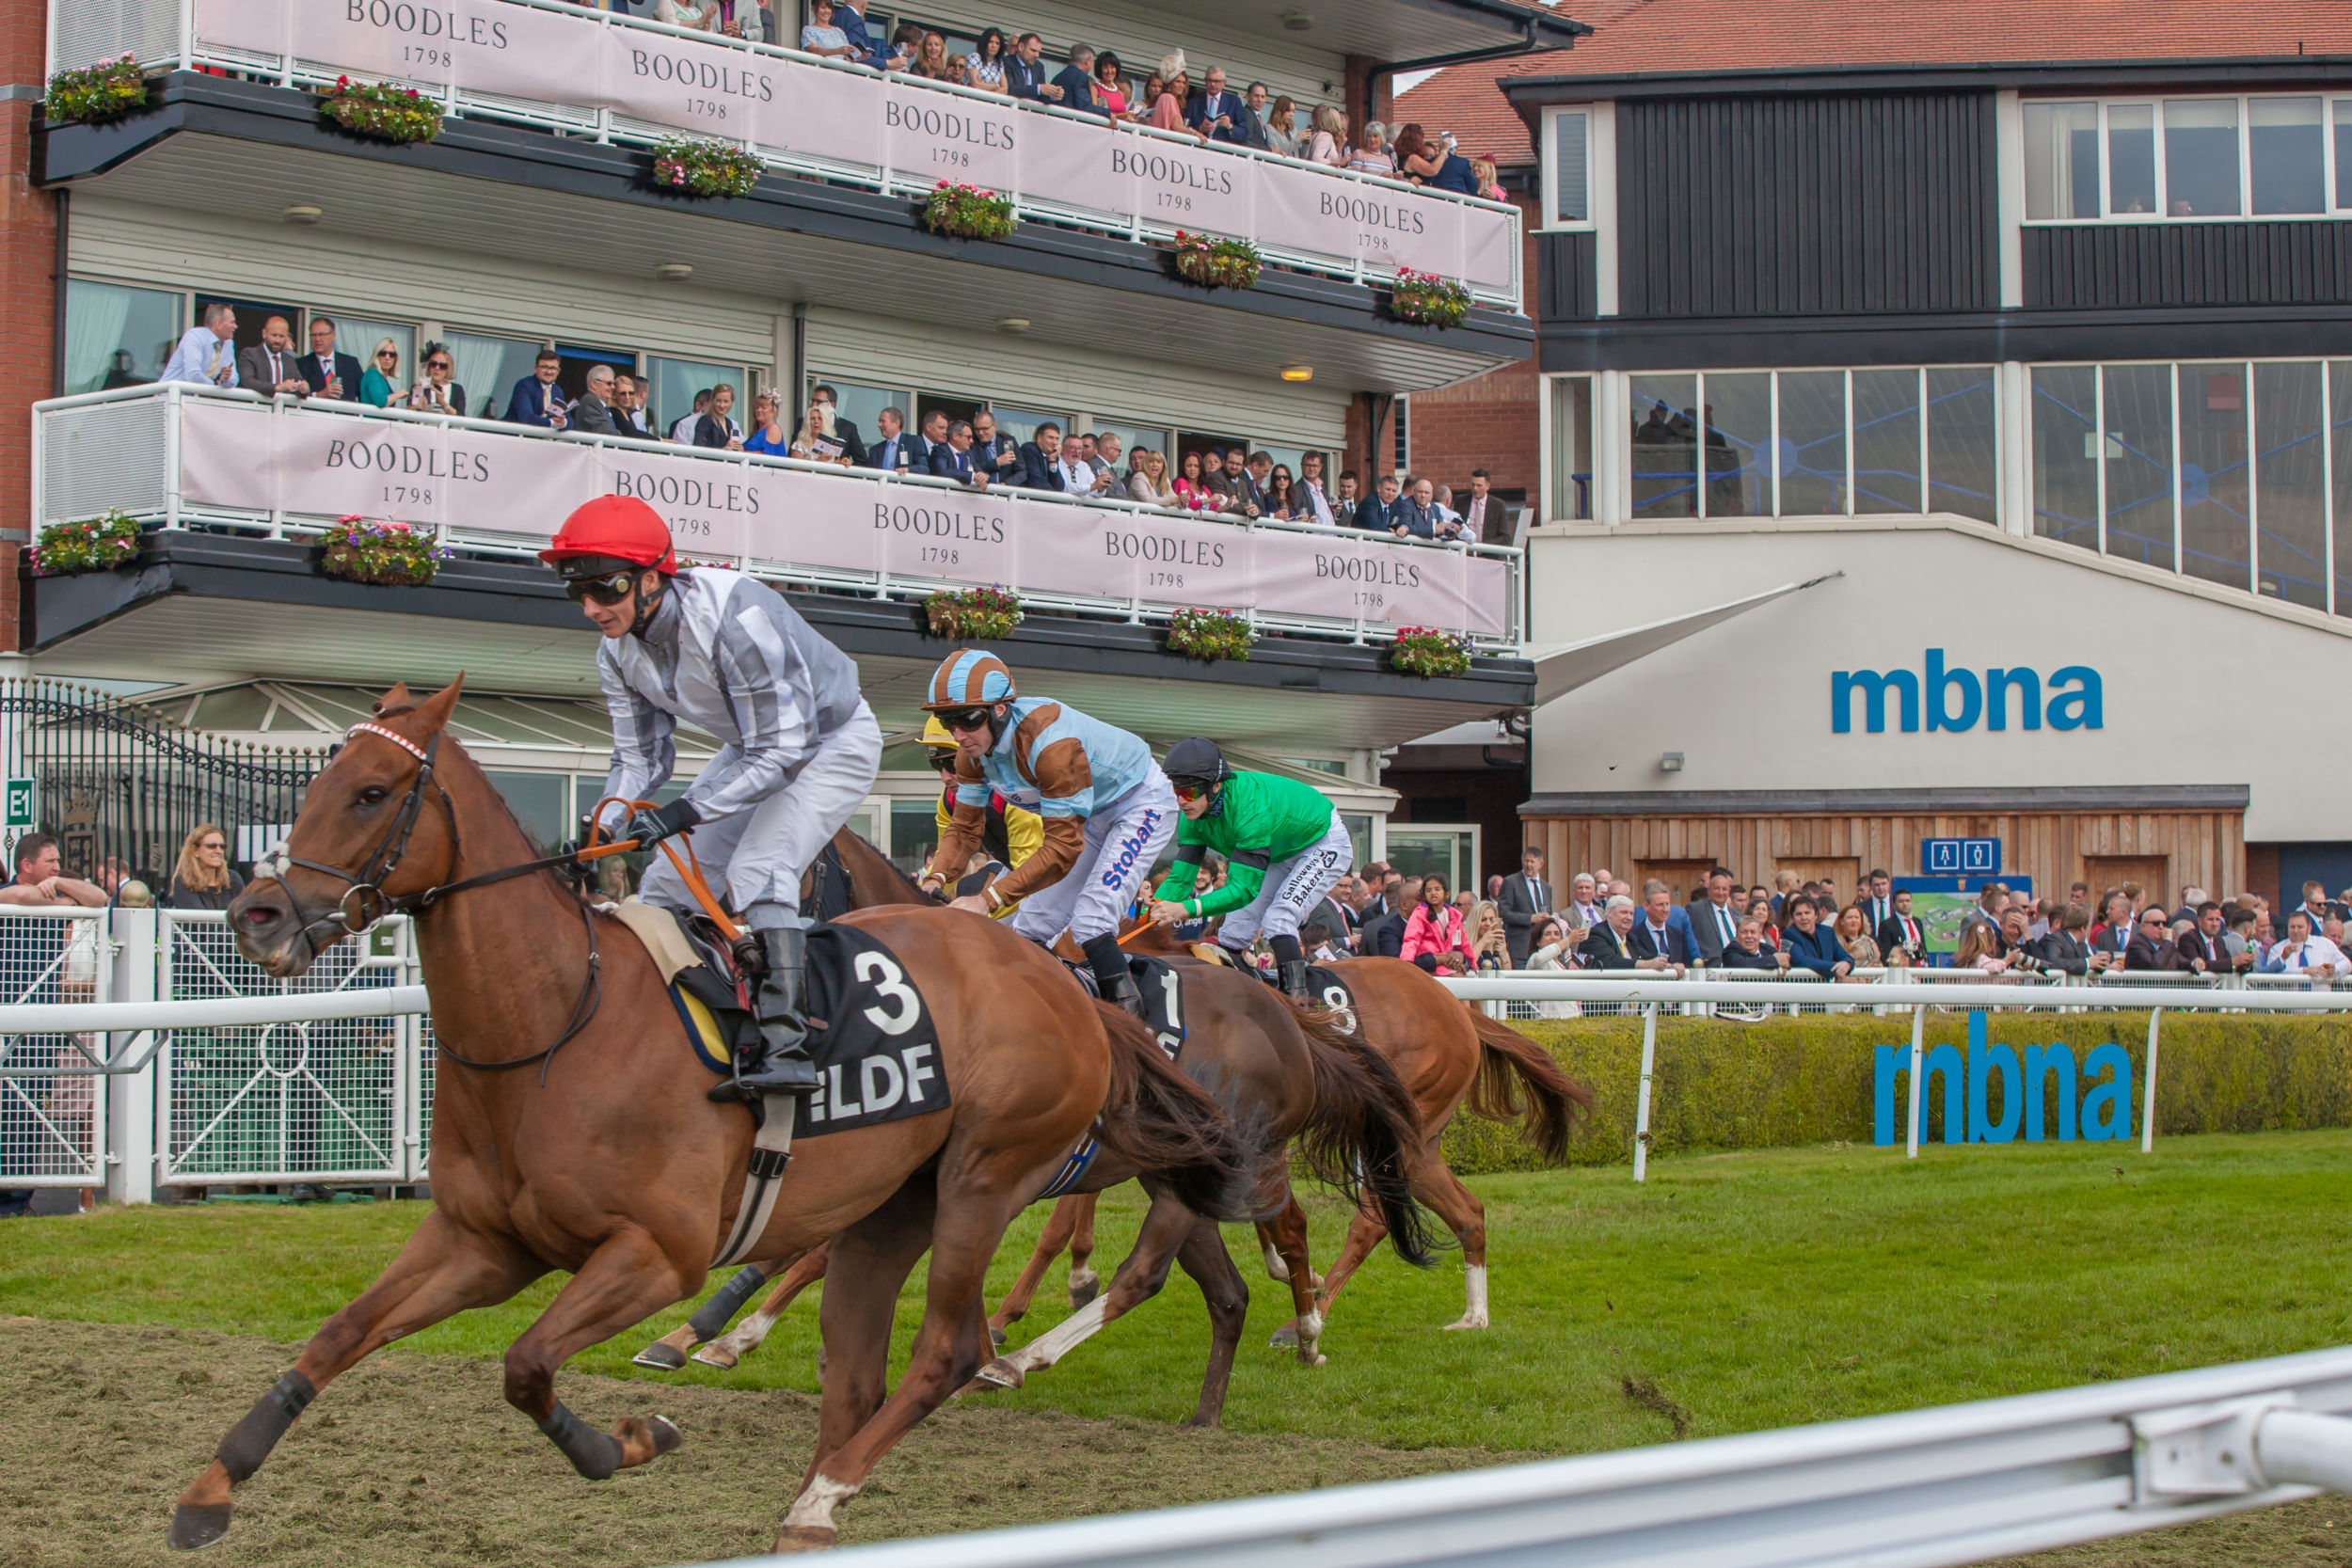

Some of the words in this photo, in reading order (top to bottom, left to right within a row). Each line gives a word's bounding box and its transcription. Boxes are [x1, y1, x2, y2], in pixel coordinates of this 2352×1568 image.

[346, 0, 508, 49] BOODLES
[404, 46, 452, 69] 1798
[632, 50, 773, 103] BOODLES
[687, 99, 726, 119] 1798
[885, 101, 1015, 150] BOODLES
[932, 148, 969, 167] 1798
[1112, 149, 1232, 195] BOODLES
[1157, 193, 1192, 212] 1798
[1320, 192, 1424, 234] BOODLES
[1358, 234, 1389, 250] 1798
[326, 440, 489, 483] BOODLES
[383, 486, 433, 505] 1798
[615, 470, 759, 515] BOODLES
[668, 517, 711, 536] 1798
[874, 502, 1005, 544] BOODLES
[921, 547, 959, 564] 1798
[1105, 531, 1225, 567] BOODLES
[1149, 572, 1184, 589] 1798
[1315, 554, 1420, 588] BOODLES
[1354, 593, 1384, 608] 1798
[1832, 648, 2104, 734] mbna
[10, 789, 29, 816] E1
[1102, 808, 1162, 892] Stobart
[1281, 857, 1320, 900] Galloways
[1292, 869, 1325, 908] Bakers
[854, 950, 921, 1036] 3
[1160, 969, 1182, 1029] 1
[1323, 985, 1357, 1036] 8
[1874, 1010, 2132, 1146] mbna
